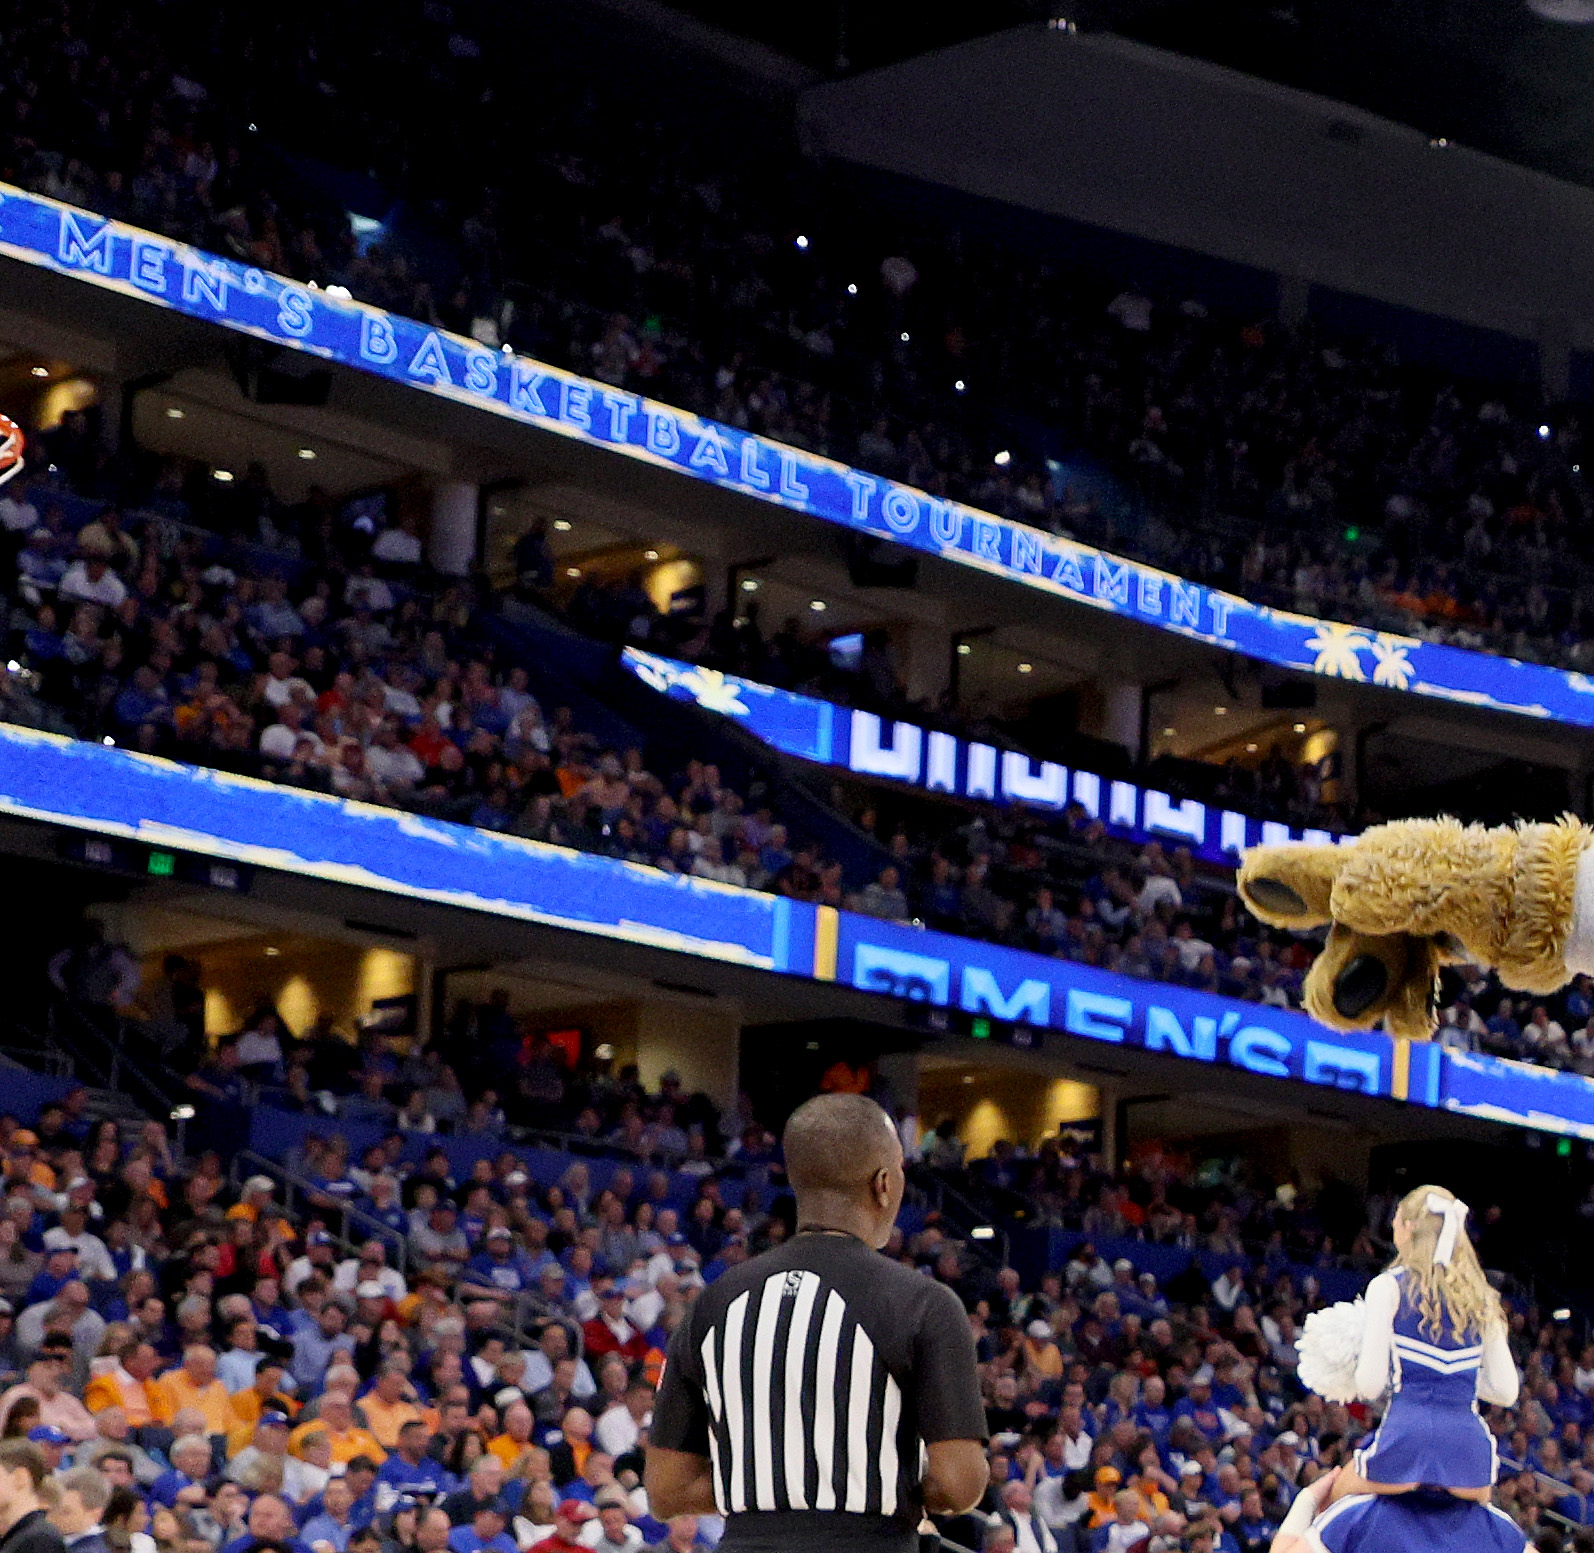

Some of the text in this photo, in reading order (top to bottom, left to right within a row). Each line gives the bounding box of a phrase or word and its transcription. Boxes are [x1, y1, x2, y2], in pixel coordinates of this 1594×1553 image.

[58, 208, 1235, 638] MEN'S BASKETBALL TOURNAMENT
[960, 962, 1295, 1079] MEN'S
